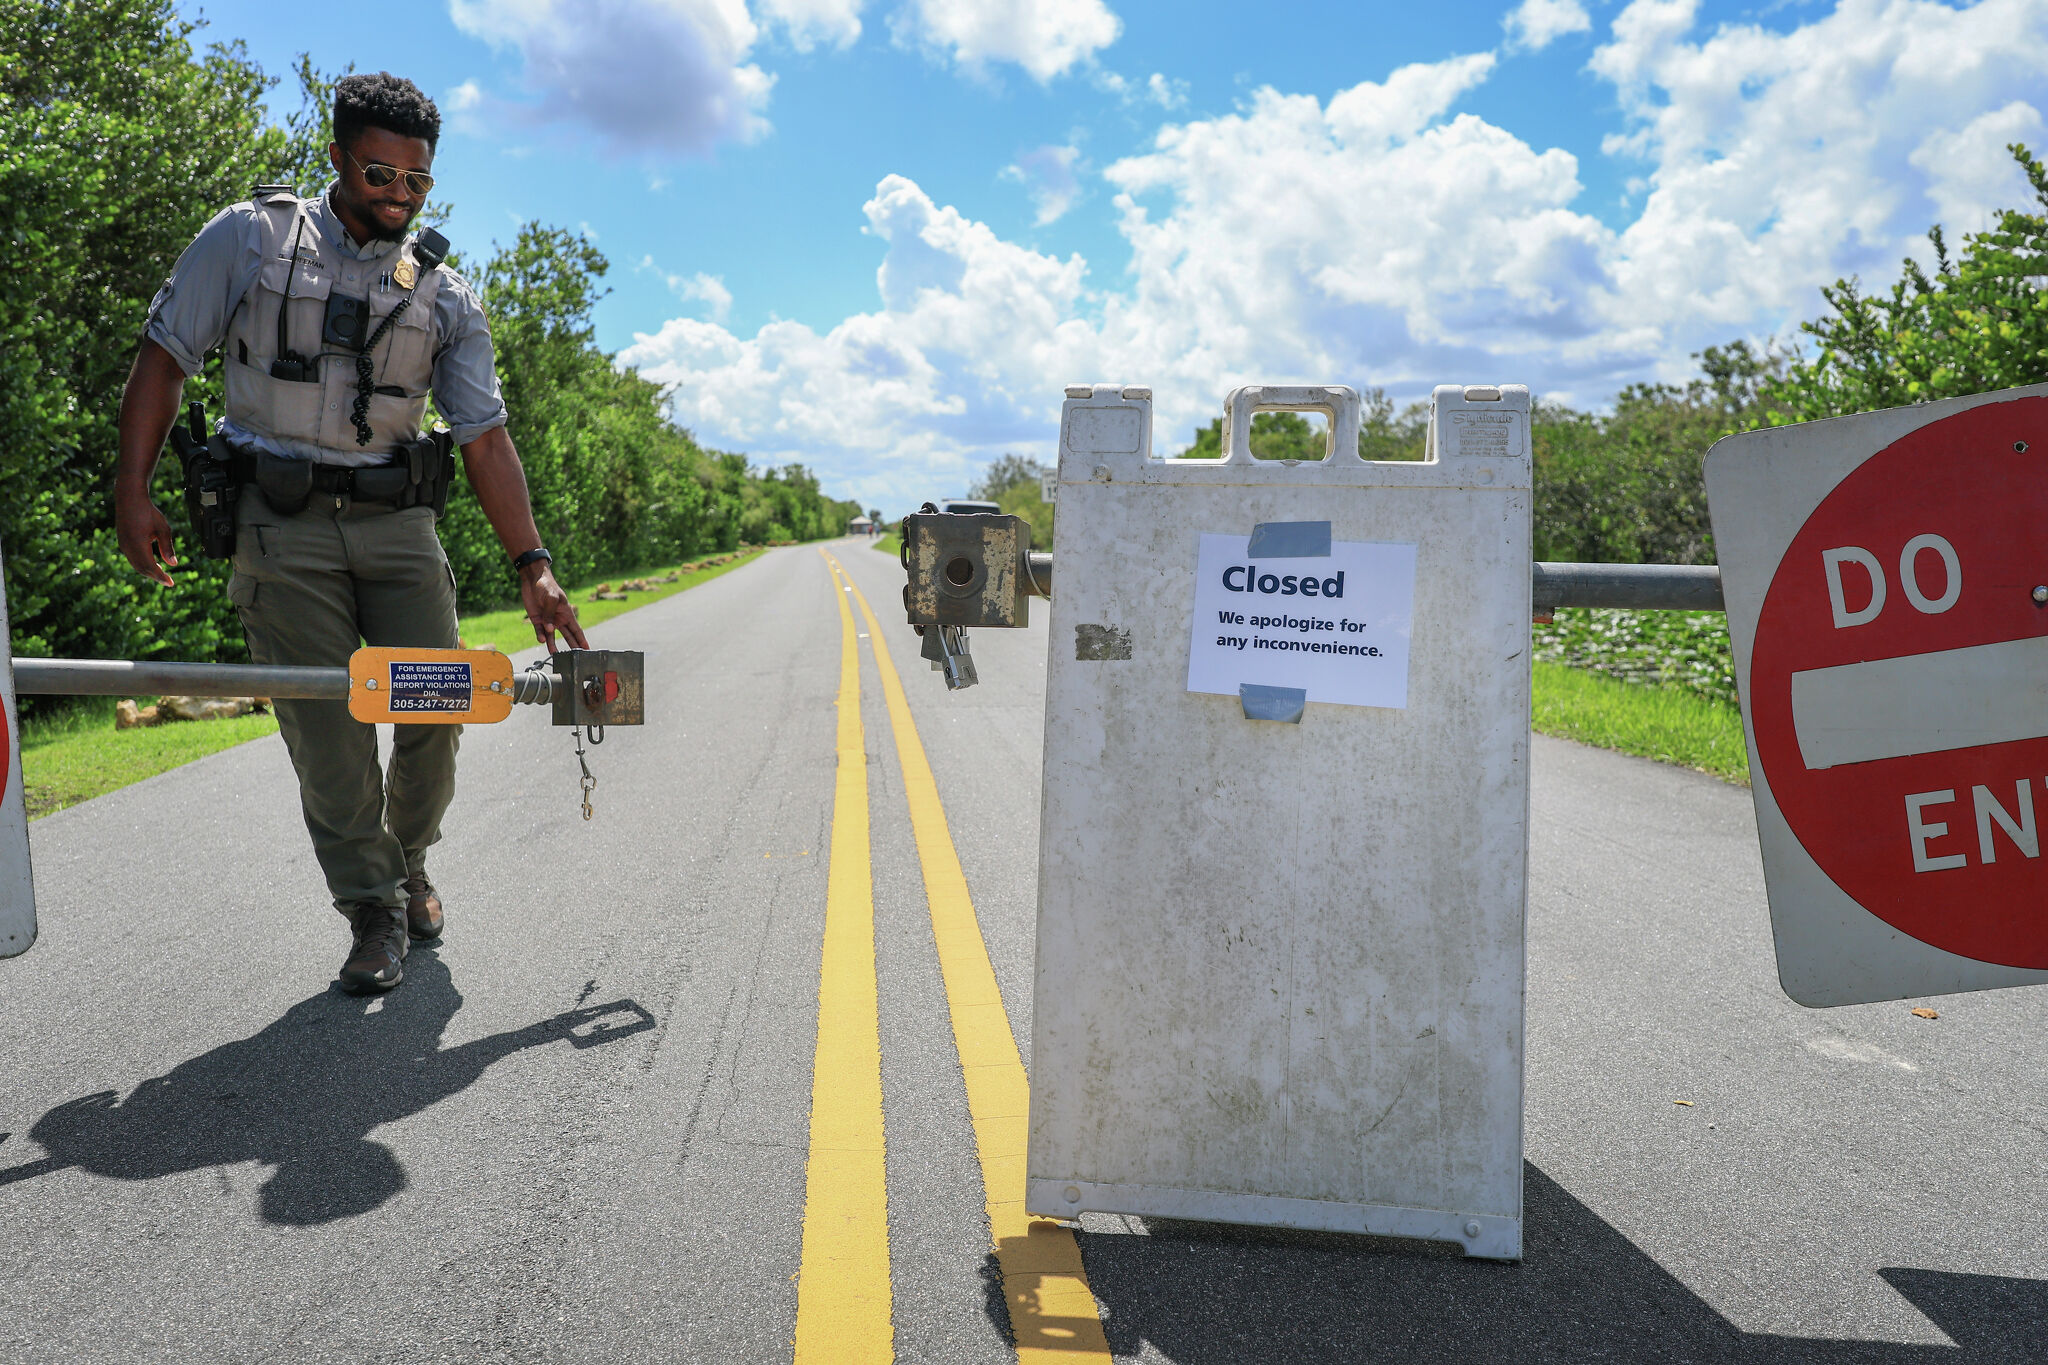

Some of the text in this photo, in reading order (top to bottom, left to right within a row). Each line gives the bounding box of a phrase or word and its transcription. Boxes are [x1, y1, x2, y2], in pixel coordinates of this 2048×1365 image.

[1222, 565, 1345, 598] Closed
[1822, 533, 1962, 629] DO
[1218, 611, 1367, 633] We apologize for
[1216, 635, 1383, 657] any inconvenience.
[416, 665, 464, 673] EMERGENCY
[393, 699, 468, 709] 305-247-7272
[1904, 775, 2048, 874] EN
